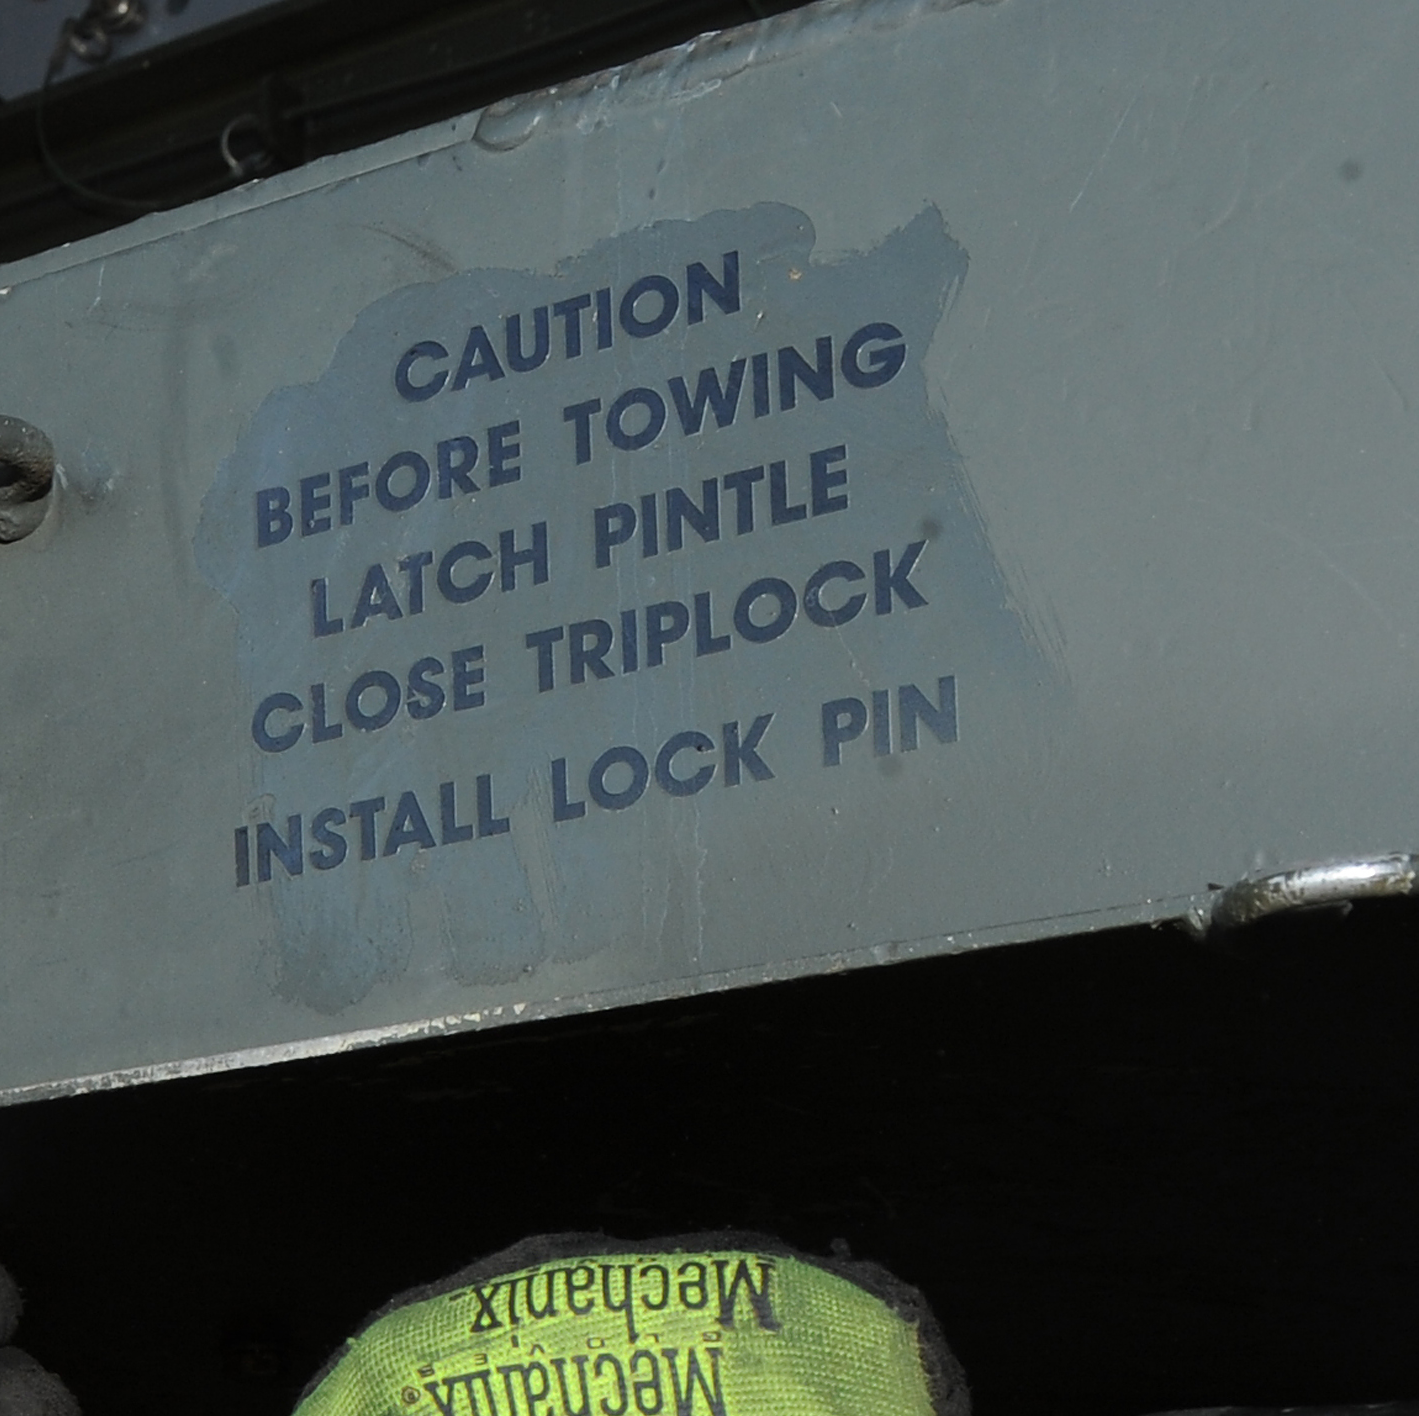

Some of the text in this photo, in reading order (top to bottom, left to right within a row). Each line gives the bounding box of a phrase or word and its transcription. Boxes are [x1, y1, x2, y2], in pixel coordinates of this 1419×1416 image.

[394, 251, 741, 402] CAUTION
[256, 322, 906, 548] BEFORE TOWING
[311, 446, 849, 637] LATCH PINTLE
[251, 541, 929, 752] CLOSE TRIPLOCK
[234, 675, 958, 888] INSTALL LOCK PIN
[469, 1258, 780, 1344] Mechanix
